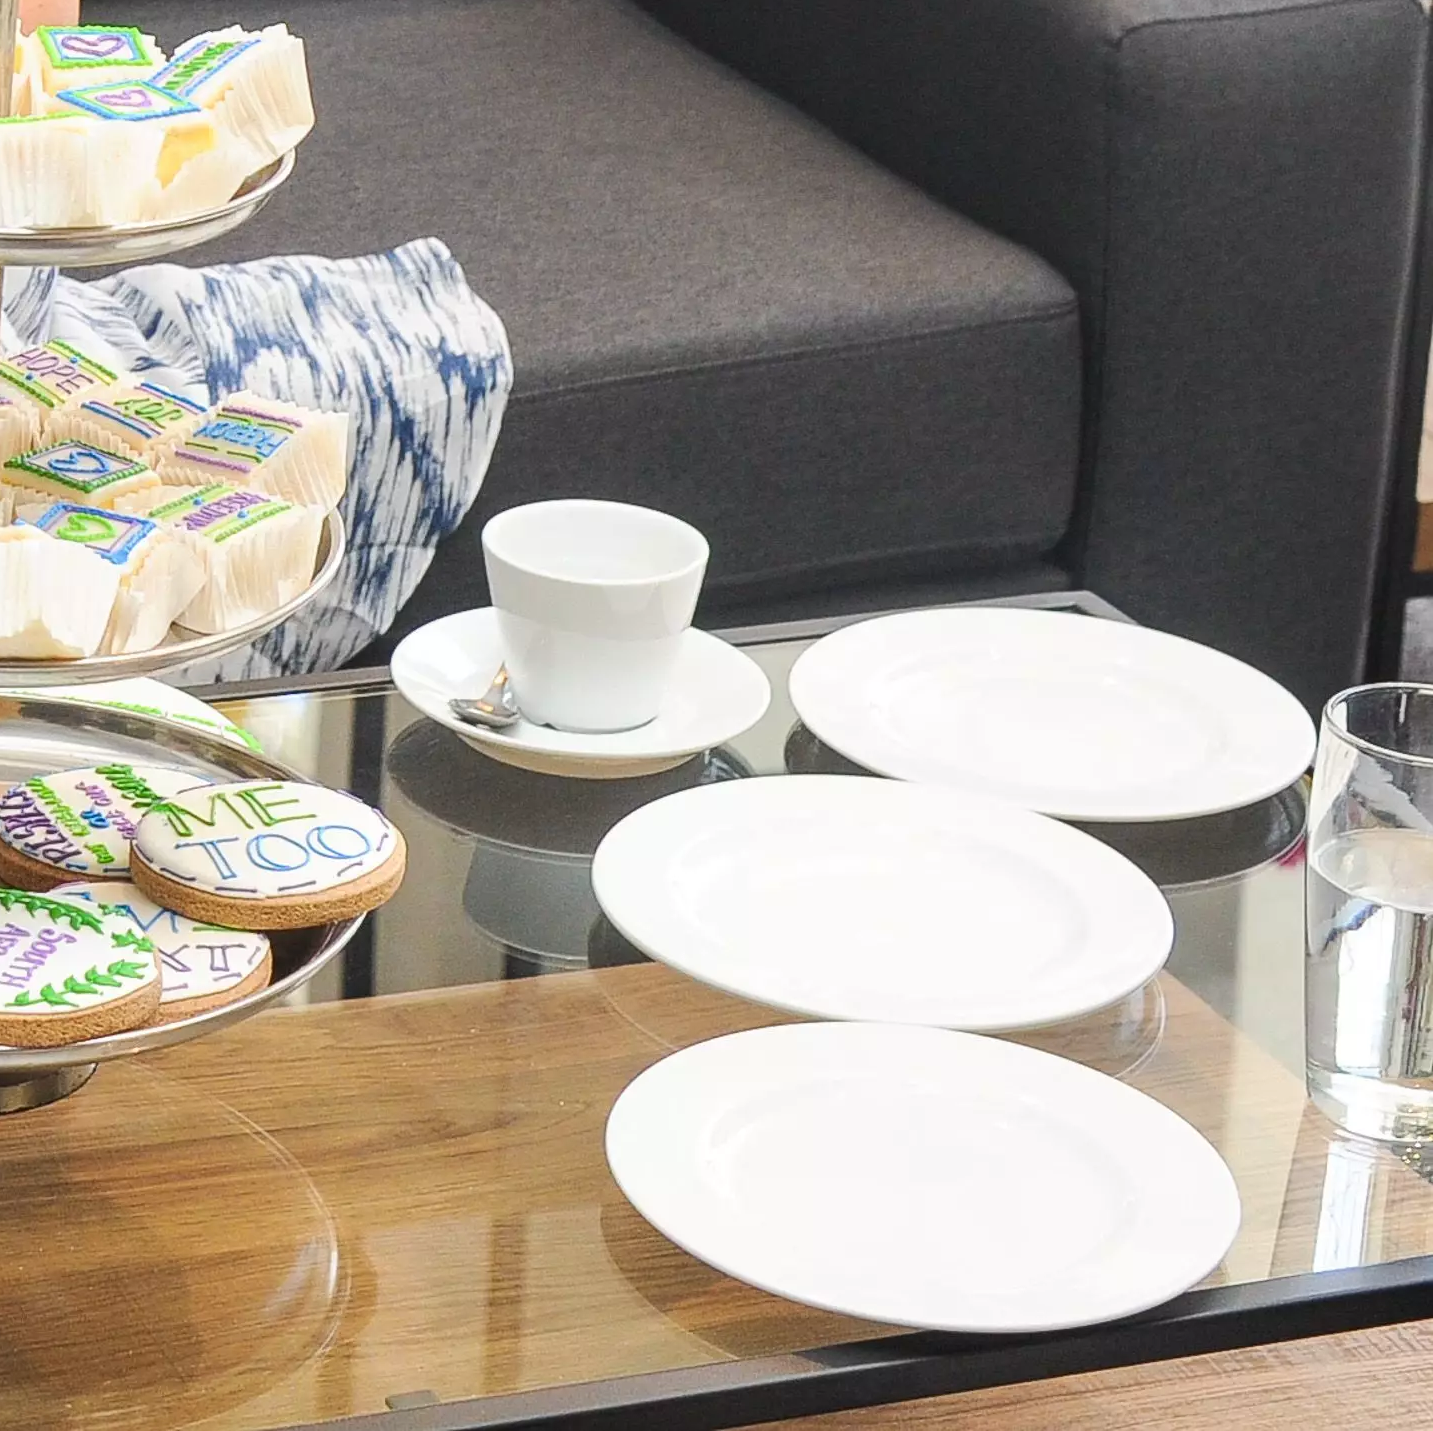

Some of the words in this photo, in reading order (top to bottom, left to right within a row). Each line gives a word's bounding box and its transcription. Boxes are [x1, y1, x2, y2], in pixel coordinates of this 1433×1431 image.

[8, 347, 95, 395] HOPE
[113, 397, 184, 430] JOY
[155, 784, 317, 837] ME
[174, 824, 371, 880] TOO
